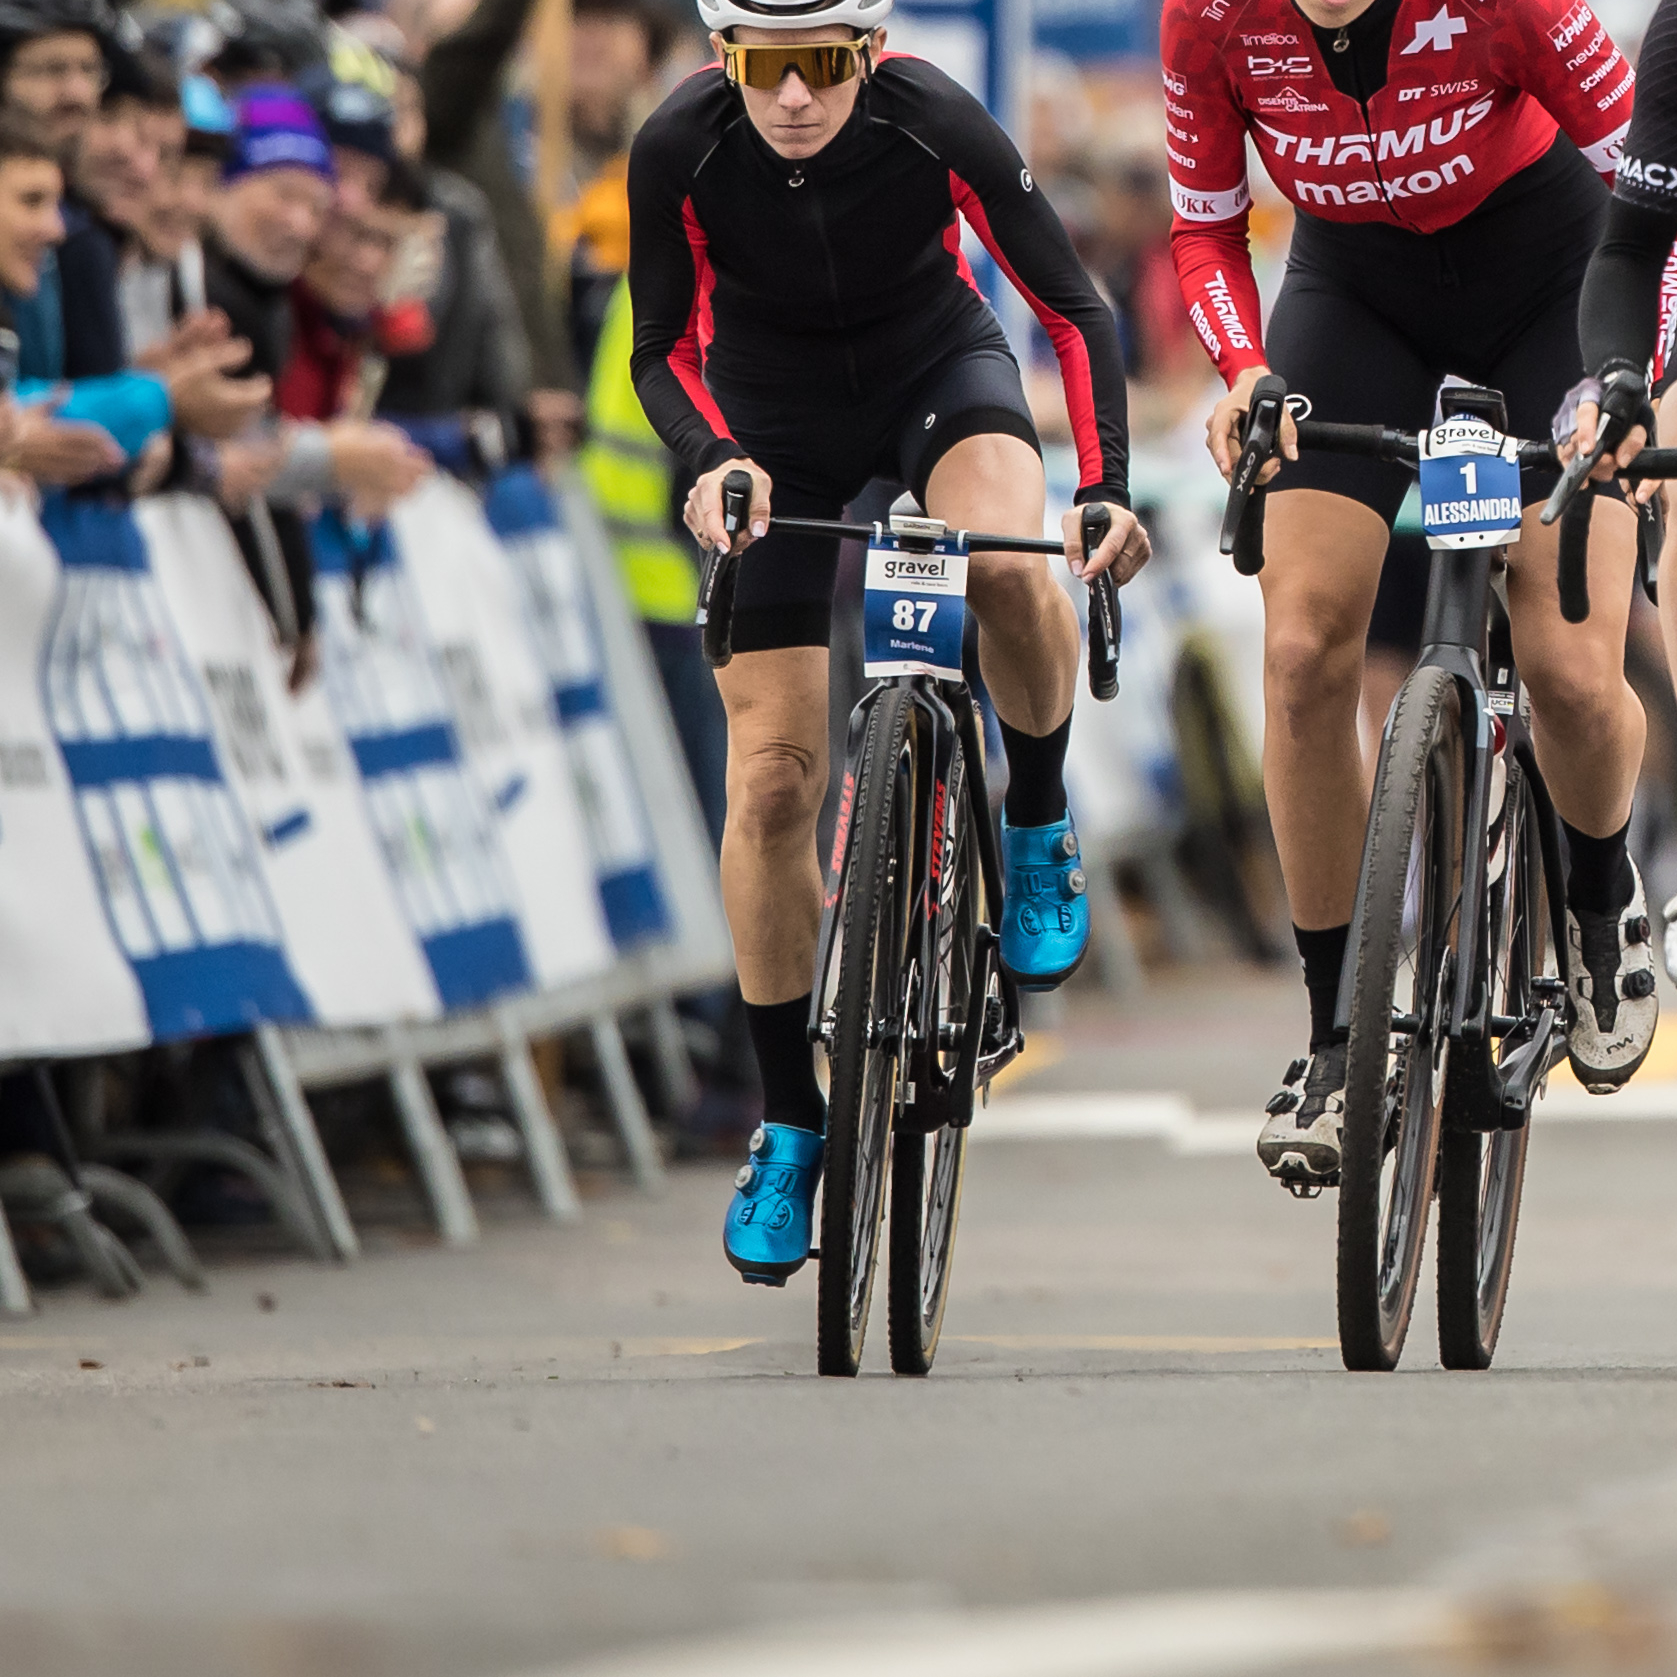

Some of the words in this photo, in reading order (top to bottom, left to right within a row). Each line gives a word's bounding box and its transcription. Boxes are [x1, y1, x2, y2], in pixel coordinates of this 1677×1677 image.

[1239, 32, 1300, 47] TimeTool
[1554, 5, 1594, 53] KPMG
[1565, 27, 1607, 72] neupla
[1398, 86, 1426, 102] DT
[1430, 78, 1480, 97] SWISS
[1294, 154, 1476, 206] maxon
[1435, 427, 1497, 445] gravel
[1459, 461, 1477, 494] 1
[1424, 497, 1523, 527] ALESSANDRA
[884, 559, 946, 579] gravel
[892, 599, 937, 633] 87
[890, 638, 935, 654] Marlene
